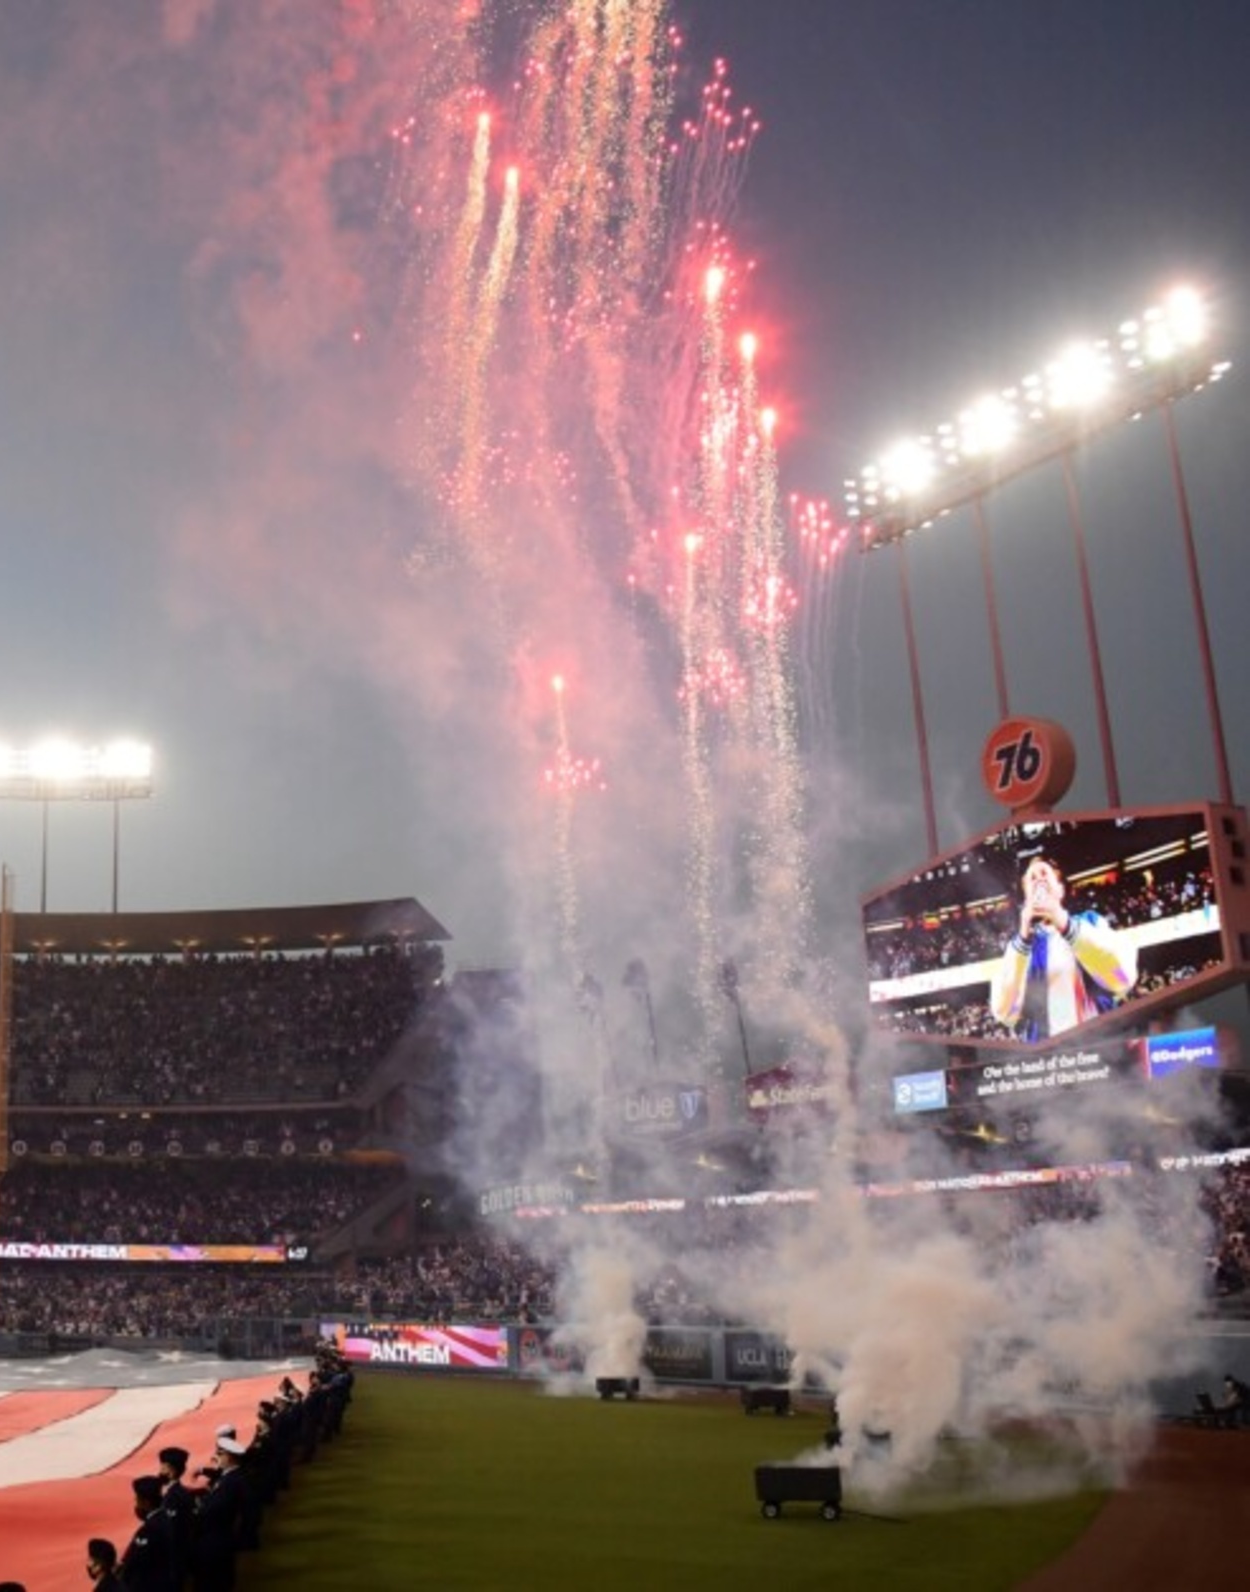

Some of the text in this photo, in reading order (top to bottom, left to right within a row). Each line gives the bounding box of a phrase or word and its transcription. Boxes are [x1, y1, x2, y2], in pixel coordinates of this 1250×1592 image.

[994, 729, 1041, 789] 76
[1022, 1059, 1044, 1073] land
[1047, 1056, 1059, 1070] of
[1045, 1073, 1057, 1087] of
[35, 1243, 127, 1259] ANTHEM
[370, 1341, 450, 1364] ANTHEM
[737, 1348, 768, 1365] UCLA
